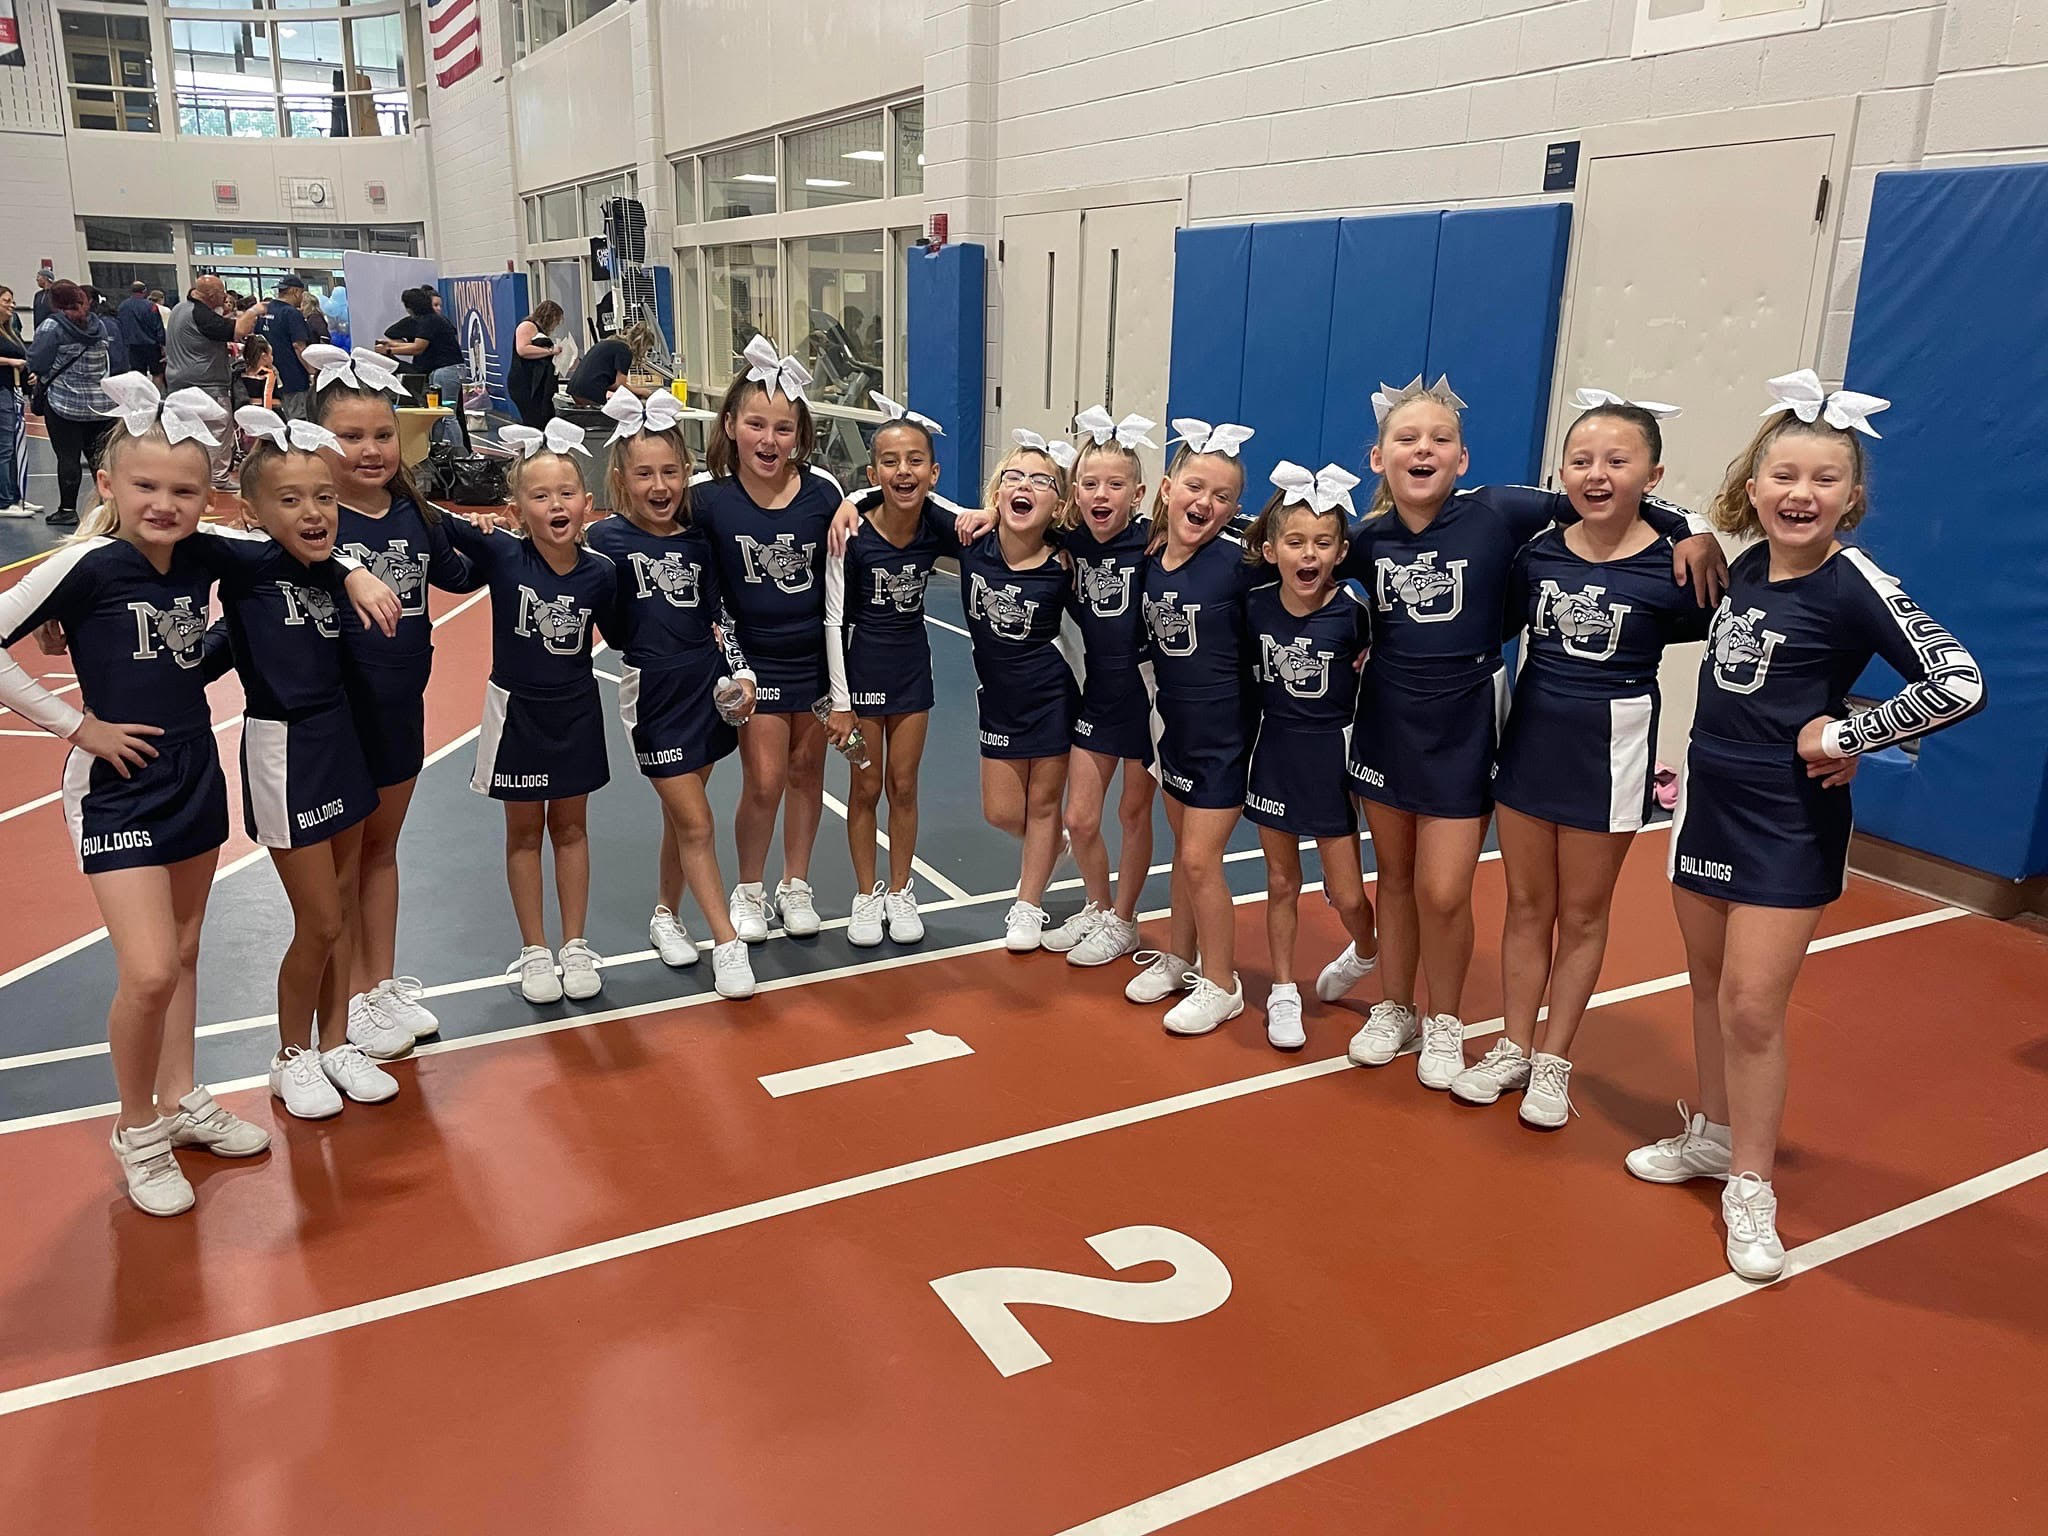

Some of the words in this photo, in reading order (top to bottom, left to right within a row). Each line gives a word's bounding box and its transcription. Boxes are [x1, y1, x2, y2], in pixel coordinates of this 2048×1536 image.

[628, 552, 702, 607] NU
[735, 533, 817, 594] NU
[871, 564, 930, 613] NU
[1375, 550, 1468, 624] NU
[514, 584, 592, 655] NU
[969, 571, 1039, 640] NU
[1534, 580, 1632, 661] NU
[1260, 634, 1334, 698] NU
[493, 773, 549, 788] BULLDOGS
[83, 830, 152, 856] BULLDOGS
[297, 799, 344, 829] BULLDOGS
[1680, 855, 1733, 882] BULLDOGS
[757, 1029, 975, 1098] 1
[929, 1225, 1233, 1378] 2
